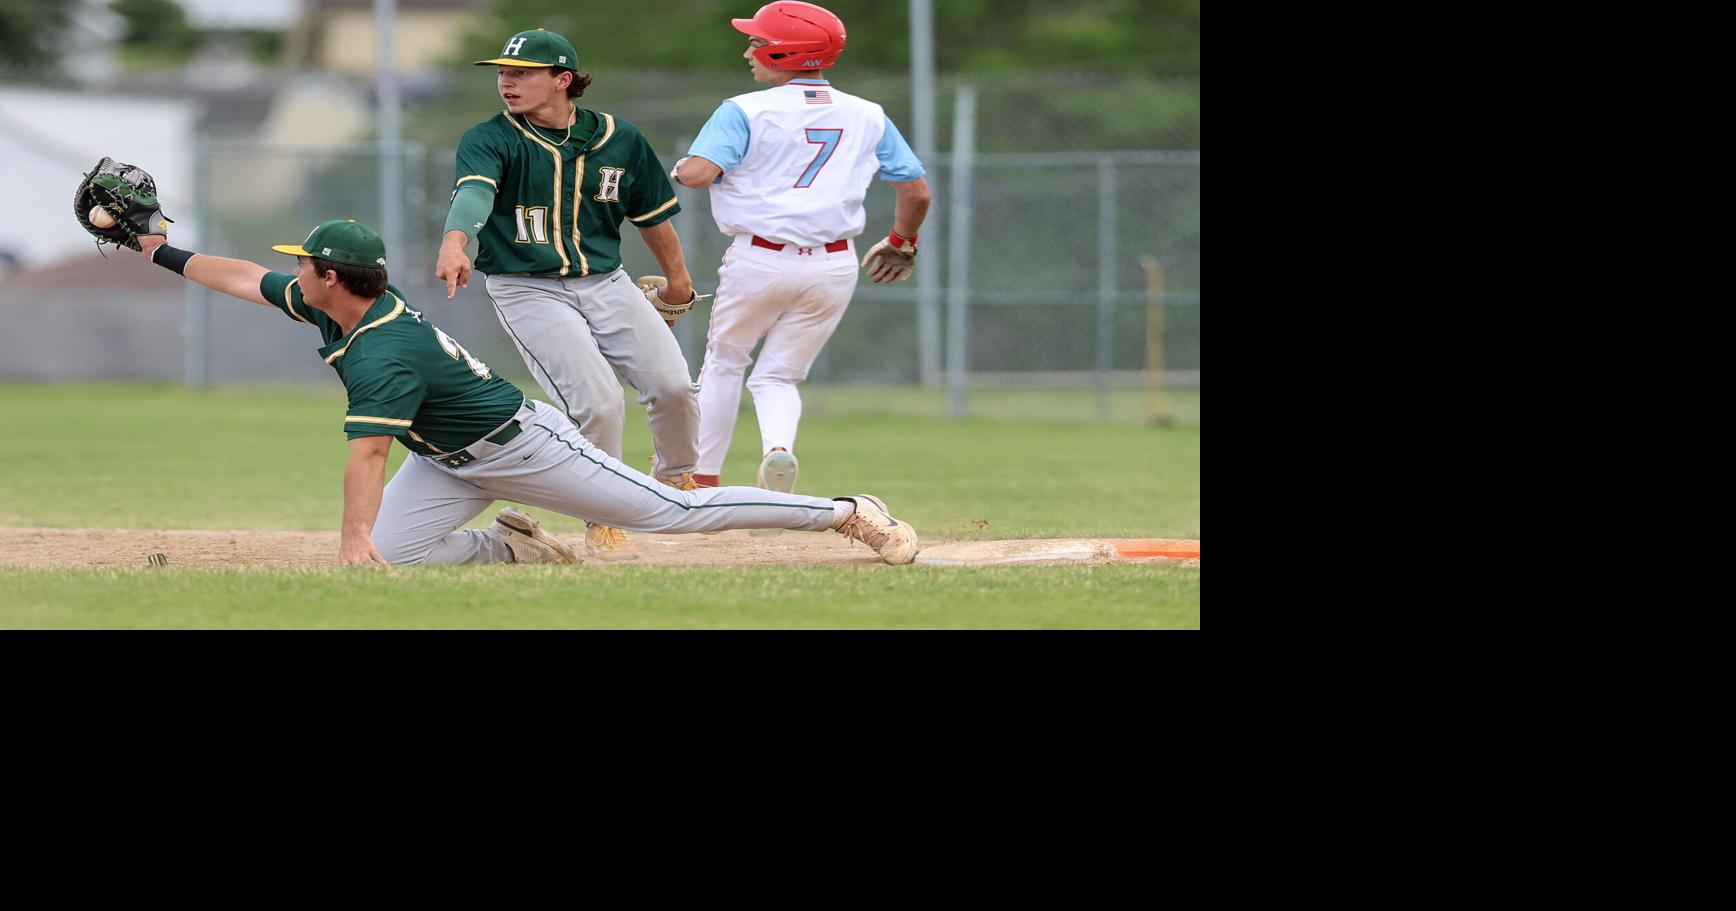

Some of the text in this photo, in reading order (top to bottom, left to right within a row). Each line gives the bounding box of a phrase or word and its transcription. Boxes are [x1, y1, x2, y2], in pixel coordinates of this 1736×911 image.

[503, 37, 527, 56] H
[793, 128, 843, 188] 7
[594, 166, 625, 202] H
[514, 205, 549, 244] 11
